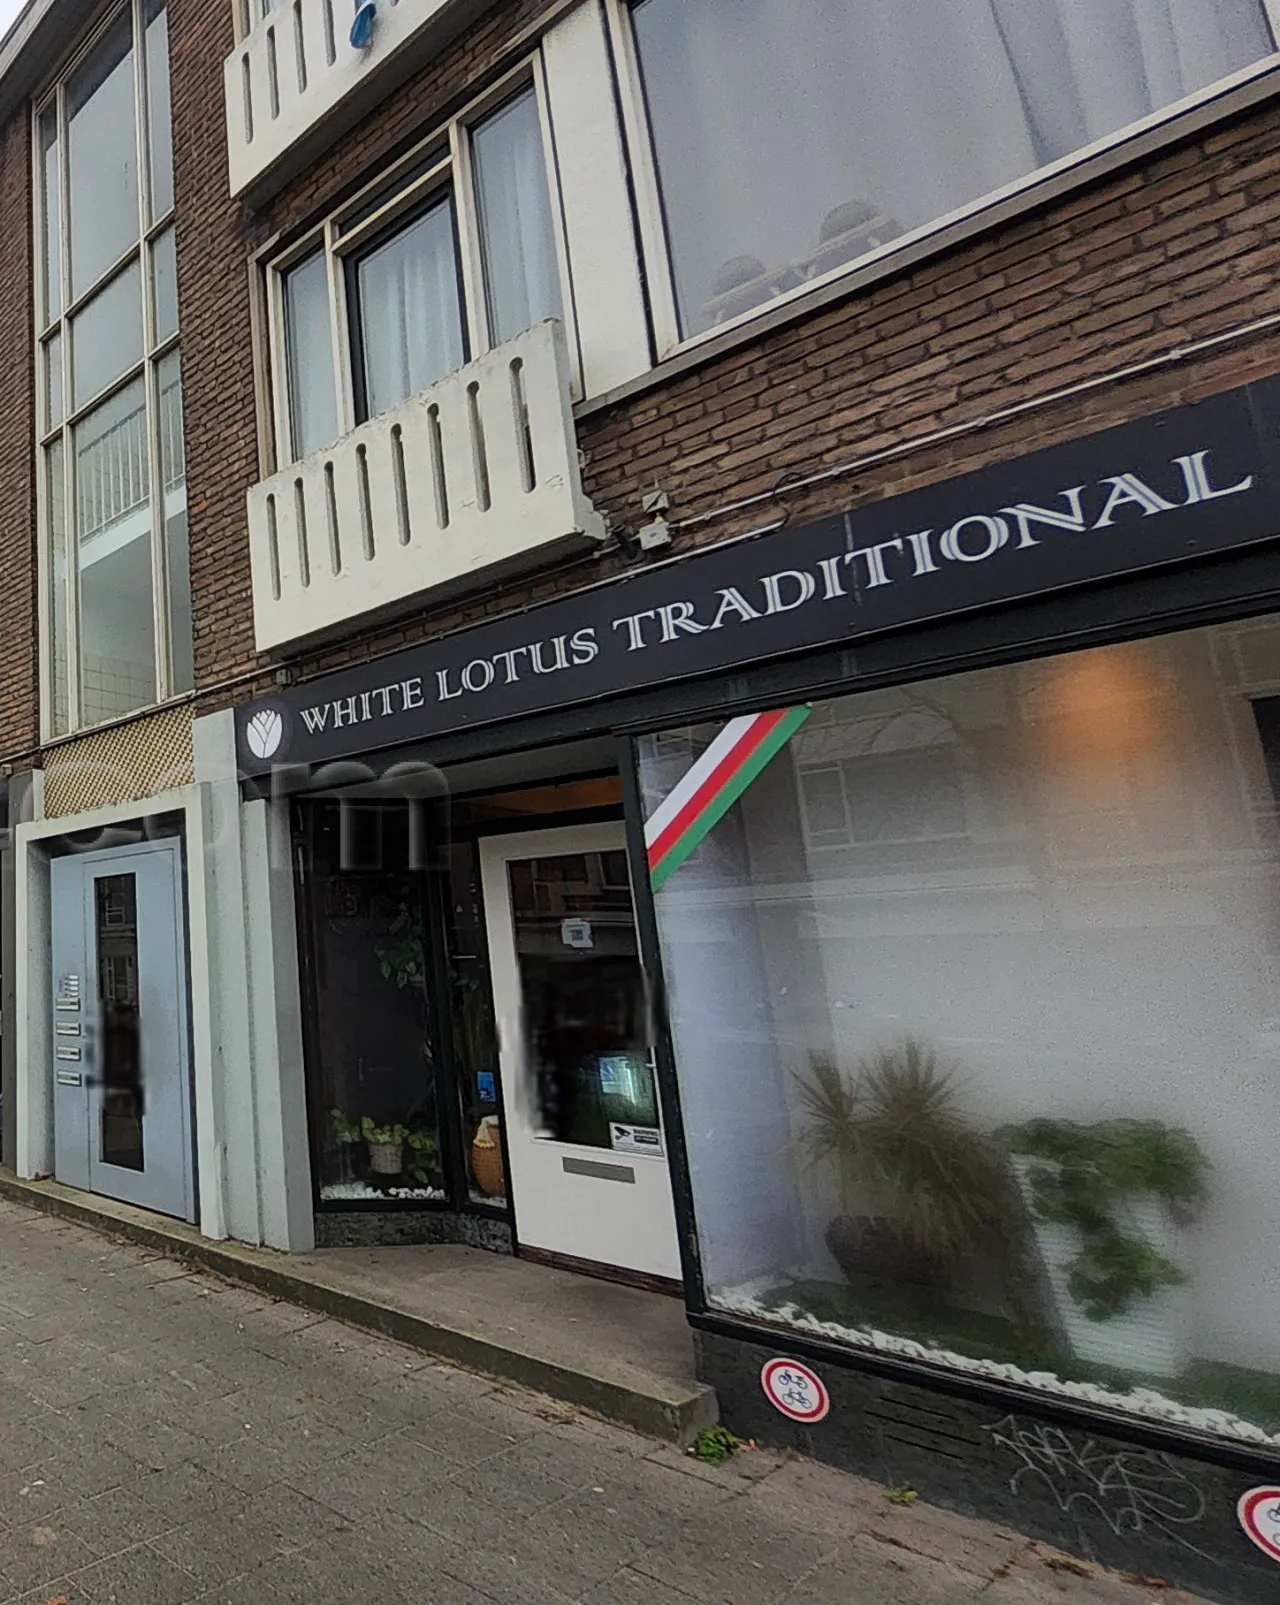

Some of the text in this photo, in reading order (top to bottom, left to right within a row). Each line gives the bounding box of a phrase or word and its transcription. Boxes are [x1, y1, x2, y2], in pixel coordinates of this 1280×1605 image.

[299, 449, 1253, 734] WHITE LOTUS TRADITIONAL
